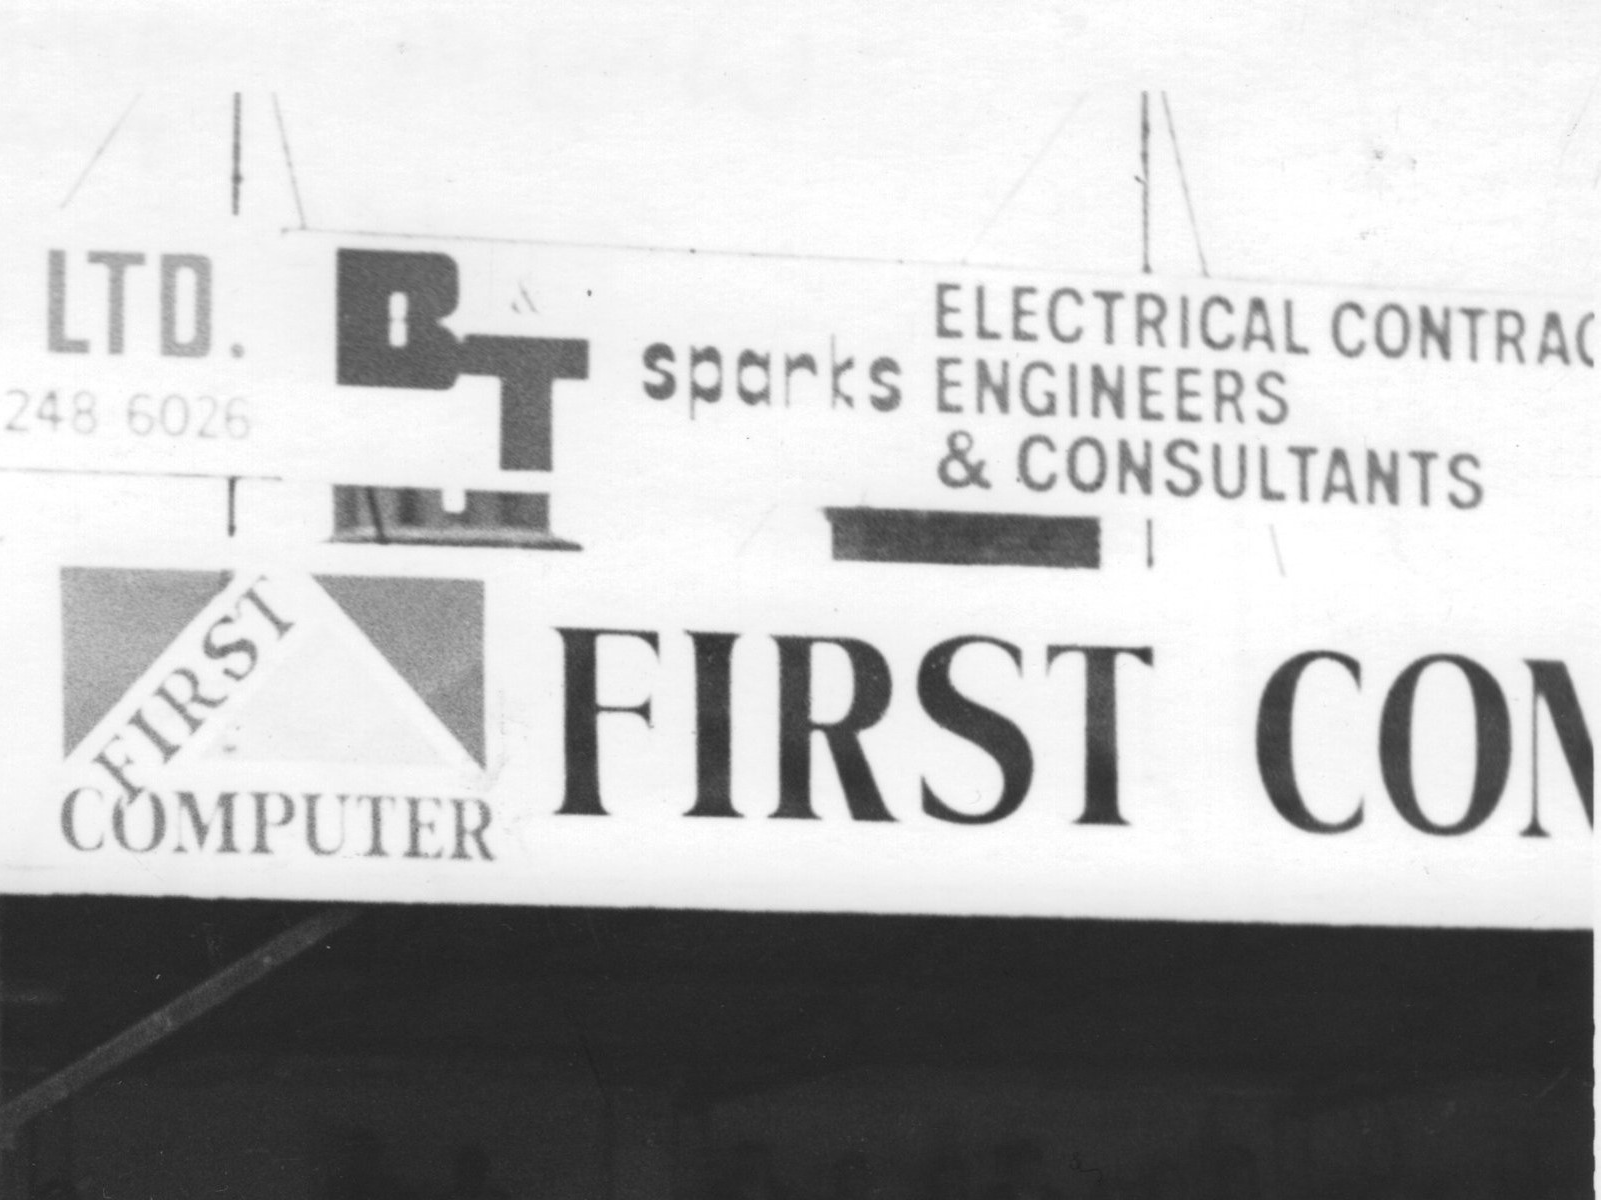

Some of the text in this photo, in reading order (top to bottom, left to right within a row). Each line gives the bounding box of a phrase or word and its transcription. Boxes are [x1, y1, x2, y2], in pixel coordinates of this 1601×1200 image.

[47, 248, 245, 359] LTD.
[935, 282, 1310, 356] ELECTRICAL
[4, 389, 98, 436] 248
[126, 390, 252, 441] 6026
[641, 335, 903, 420] sparks
[935, 357, 1290, 426] ENGINEERS
[936, 429, 1484, 511] & CONSULTANTS
[91, 574, 295, 805] FIRST
[554, 626, 1155, 826] FIRST
[59, 786, 496, 862] COMPUTER
